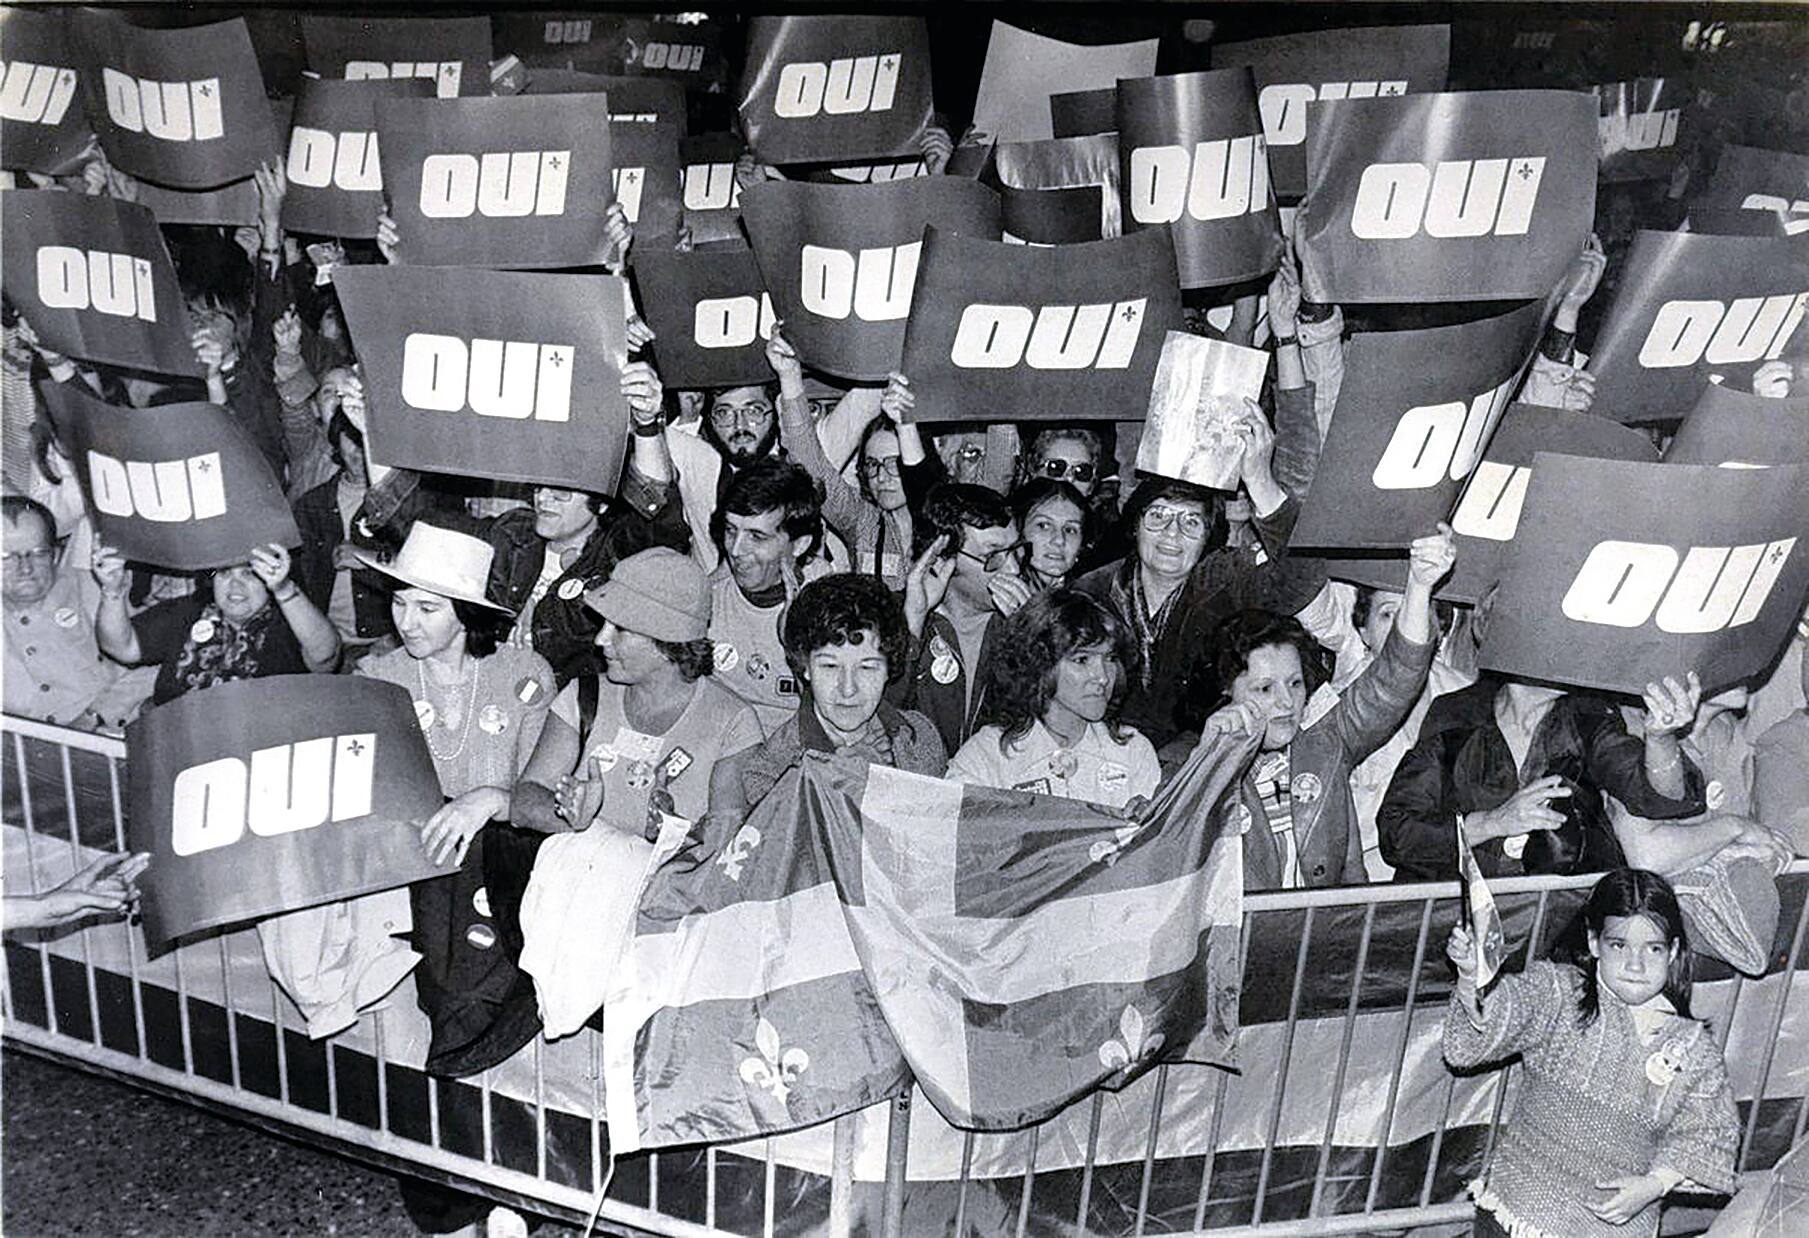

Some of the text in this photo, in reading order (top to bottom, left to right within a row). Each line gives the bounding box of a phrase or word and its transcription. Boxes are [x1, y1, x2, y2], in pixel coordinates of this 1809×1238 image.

[545, 20, 591, 43] OUI
[643, 43, 704, 71] OUI
[0, 61, 76, 124] UI
[104, 68, 224, 141] OUI
[775, 53, 902, 118] OUI
[287, 127, 383, 191] OU
[420, 151, 570, 217] OUI
[1131, 133, 1267, 223] OUI
[1351, 157, 1546, 239] OUI
[37, 246, 156, 322] OUI
[802, 241, 922, 321] OU
[951, 298, 1147, 368] OUI
[1639, 292, 1809, 368] OUI
[403, 333, 574, 421] OUI
[88, 451, 227, 522] OUI
[1562, 537, 1797, 633] OUI
[172, 733, 376, 857] OUI
